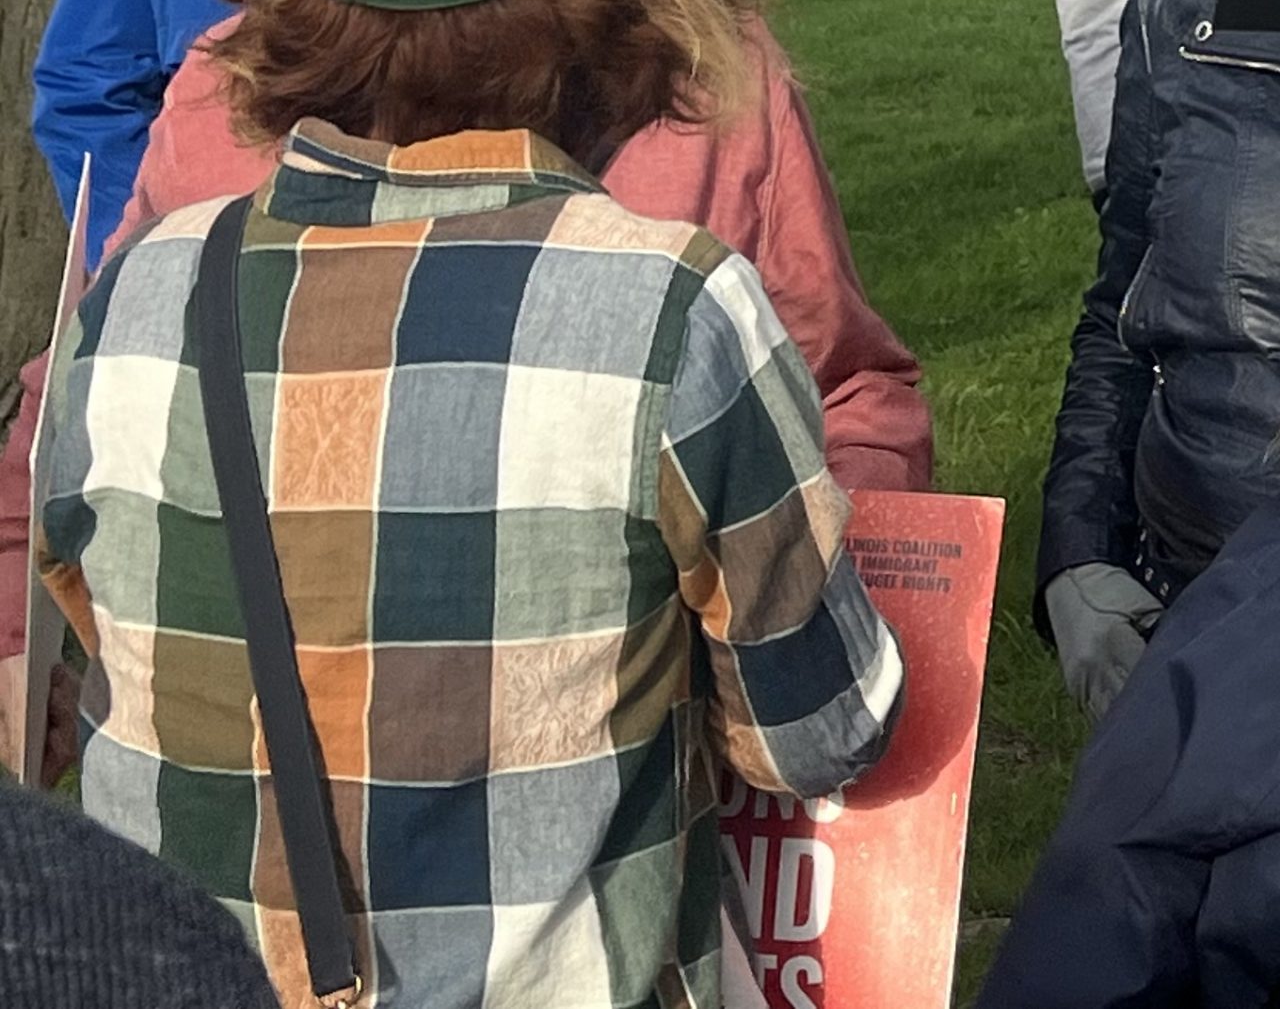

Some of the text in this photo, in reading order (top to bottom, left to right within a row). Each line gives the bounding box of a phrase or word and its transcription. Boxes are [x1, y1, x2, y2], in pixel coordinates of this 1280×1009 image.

[893, 539, 962, 559] COALITION
[861, 555, 939, 574] IMMIGRANT
[901, 575, 952, 593] RIGHTS
